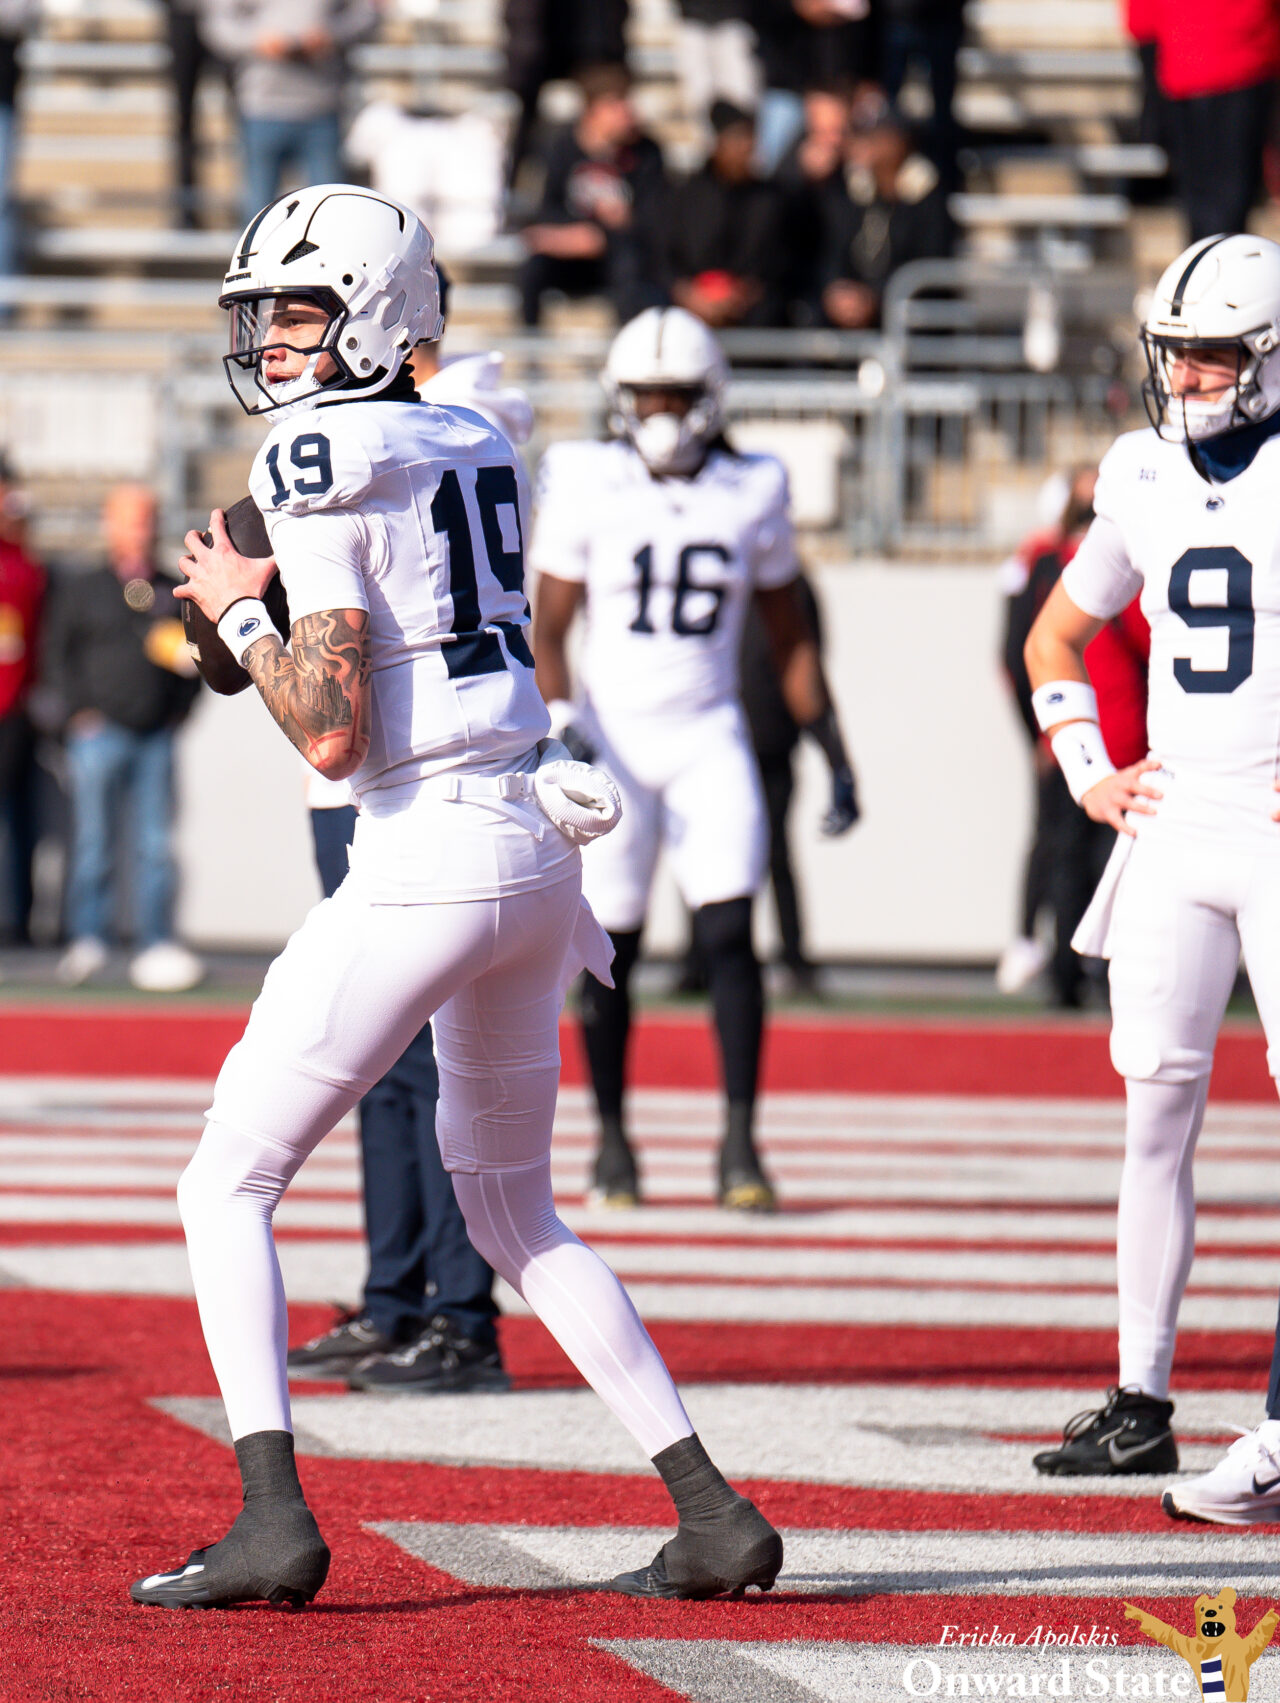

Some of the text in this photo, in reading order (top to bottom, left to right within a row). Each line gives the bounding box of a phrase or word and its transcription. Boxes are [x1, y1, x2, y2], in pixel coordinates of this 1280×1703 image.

[266, 432, 333, 507] 19
[430, 465, 536, 679] 19
[629, 543, 732, 636] 16
[1168, 546, 1255, 693] 9
